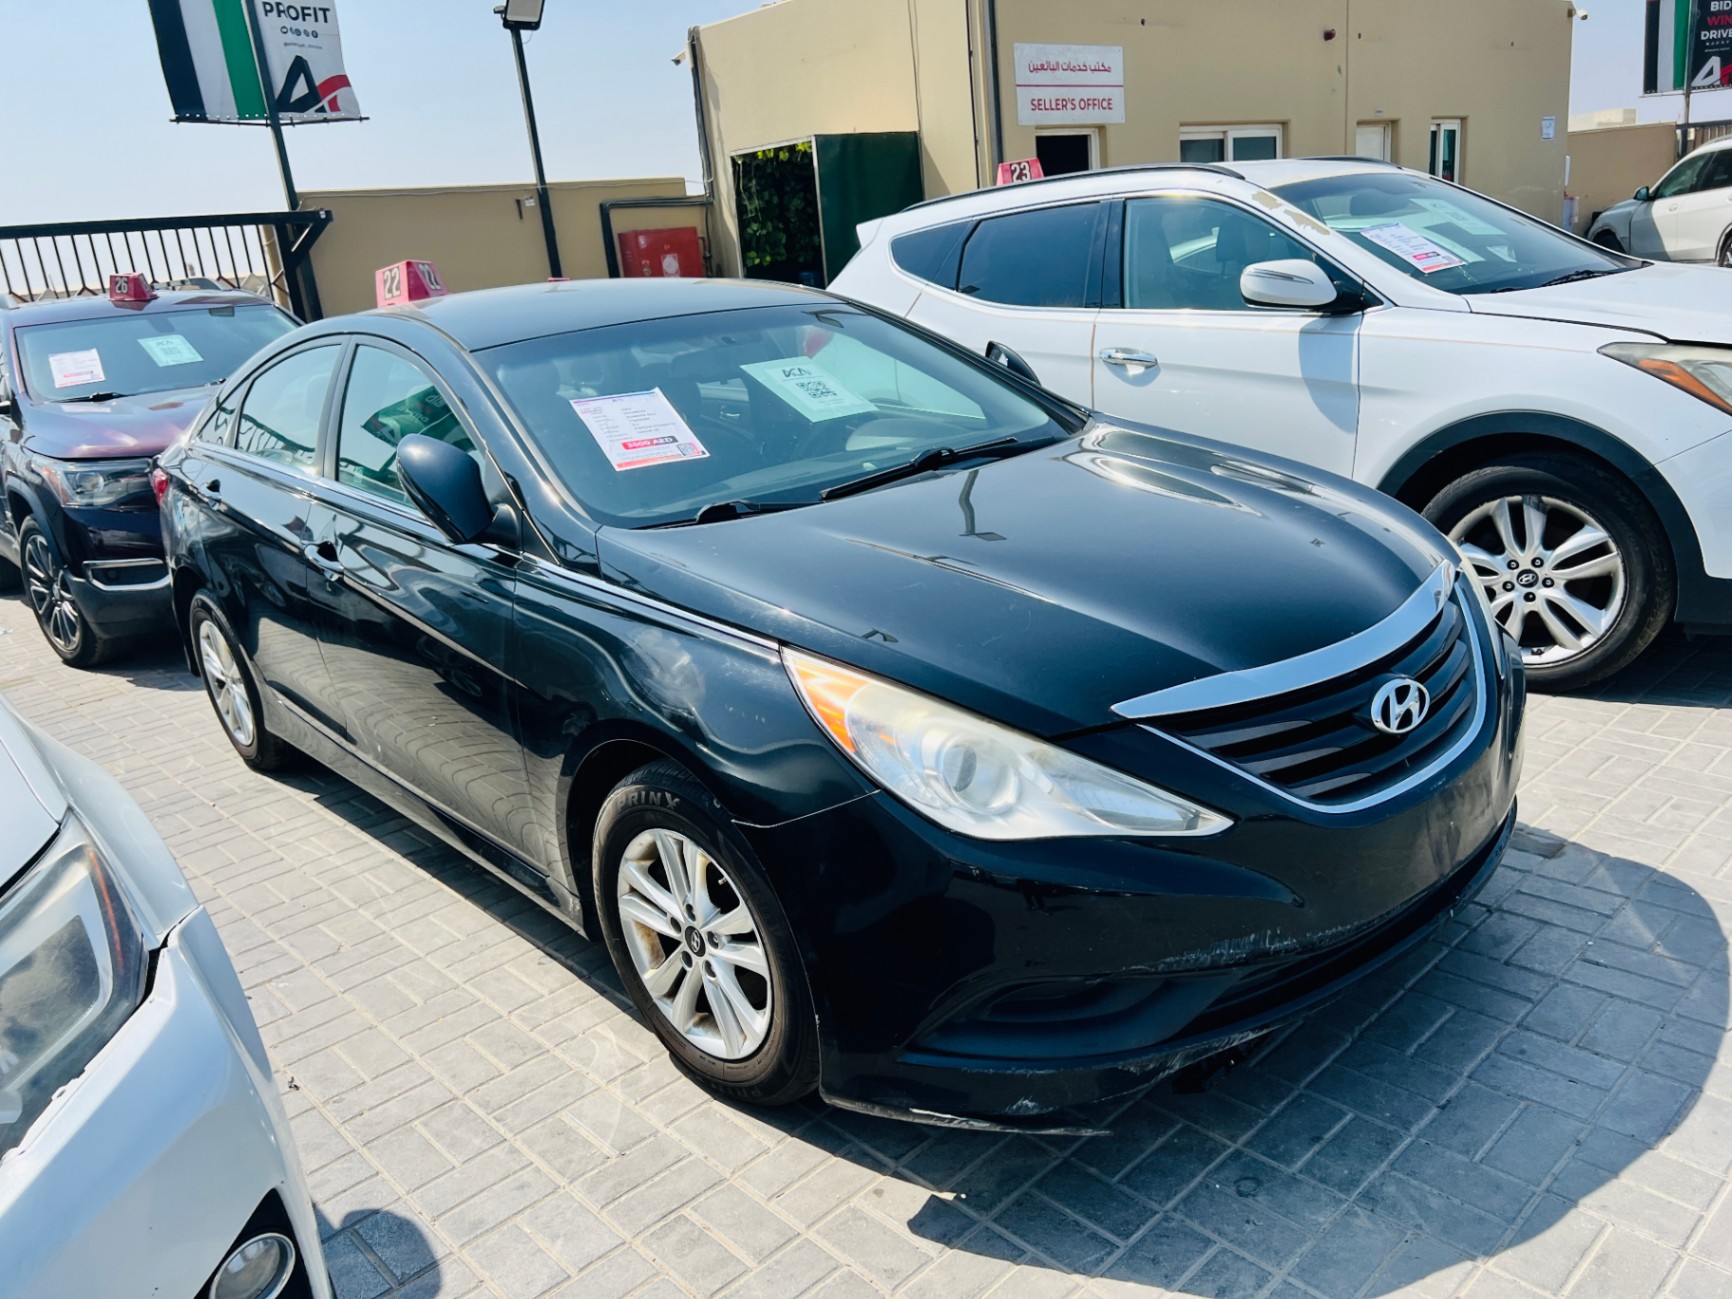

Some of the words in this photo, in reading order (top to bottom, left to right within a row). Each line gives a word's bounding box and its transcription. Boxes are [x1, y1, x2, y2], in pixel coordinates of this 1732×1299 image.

[262, 1, 331, 23] PROFIT
[1710, 1, 1732, 12] BID
[1707, 14, 1732, 26] WIN
[1028, 59, 1060, 74] البائعين
[1061, 60, 1088, 73] خدمات
[1089, 60, 1112, 74] مكتب
[1031, 98, 1076, 111] SELLER'S
[1078, 98, 1113, 111] OFFICE
[1011, 161, 1031, 183] 23
[115, 276, 129, 294] 26
[384, 267, 401, 300] 22
